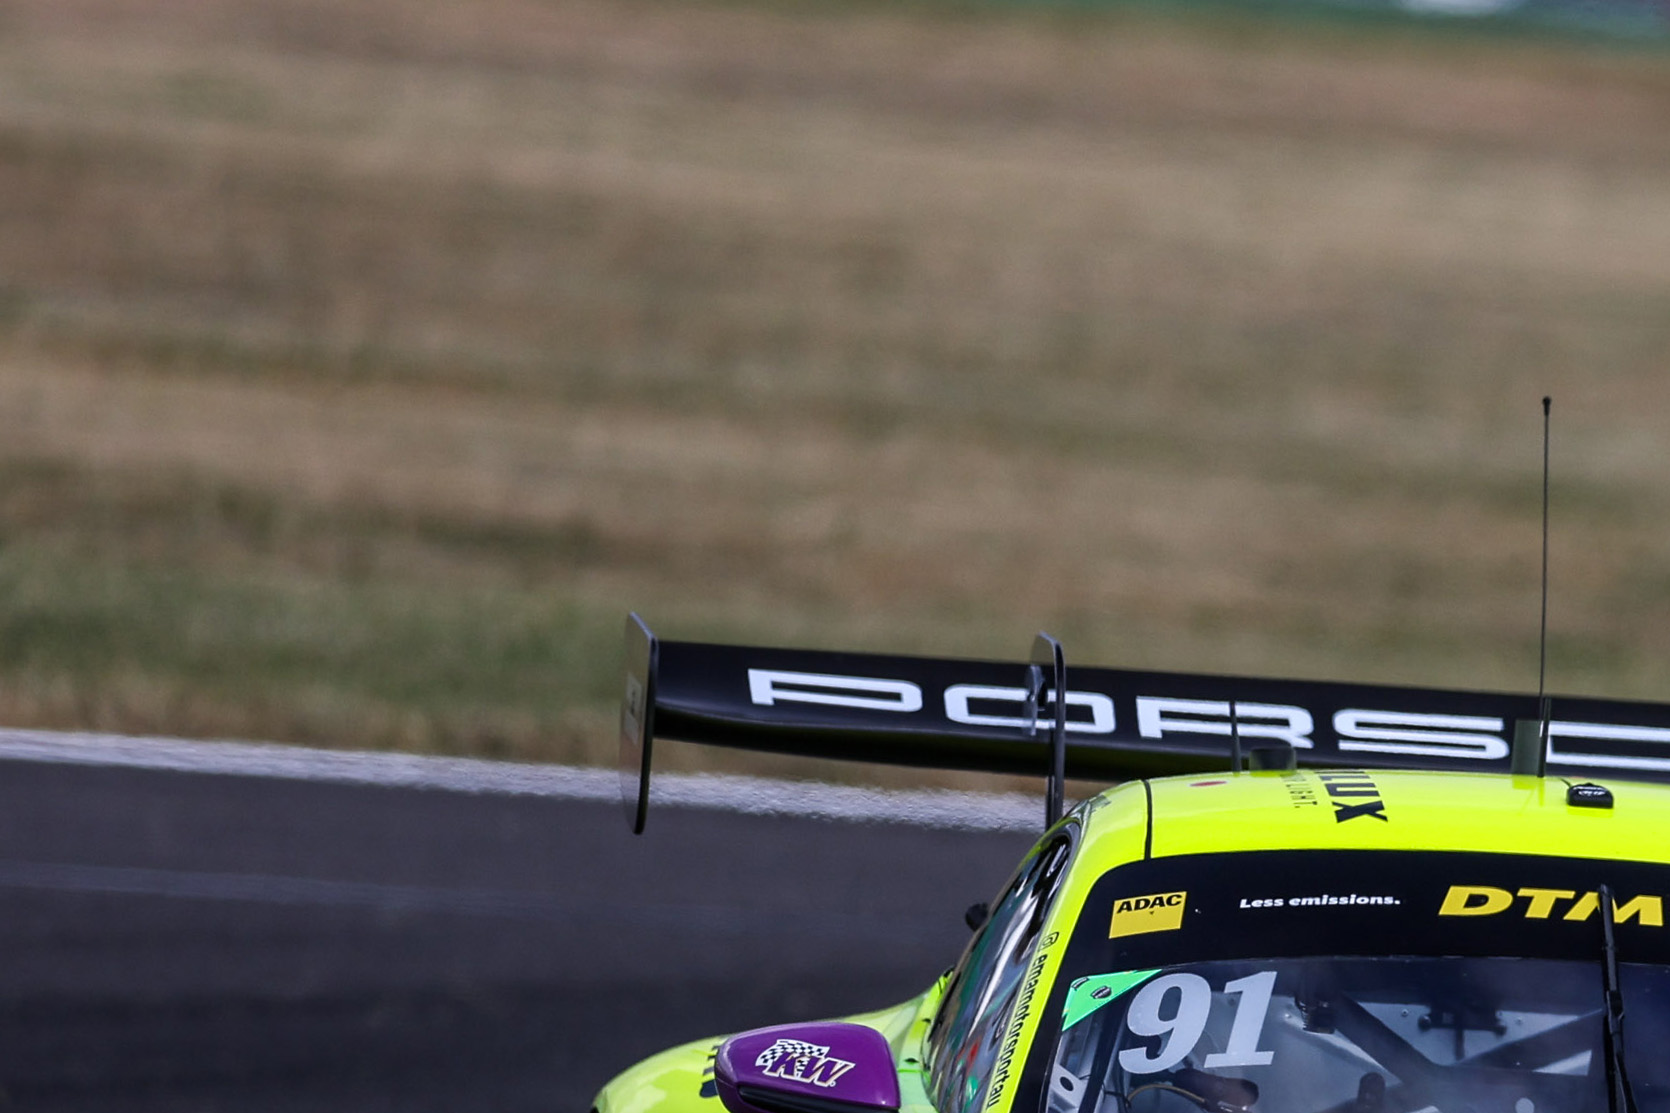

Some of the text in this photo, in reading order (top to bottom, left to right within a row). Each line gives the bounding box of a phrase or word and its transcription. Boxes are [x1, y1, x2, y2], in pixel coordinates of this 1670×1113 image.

[1116, 893, 1183, 914] ADAC
[1239, 894, 1401, 909] Less emissions.
[1438, 885, 1663, 927] DTM
[1118, 970, 1278, 1075] 91
[764, 1051, 856, 1088] KW
